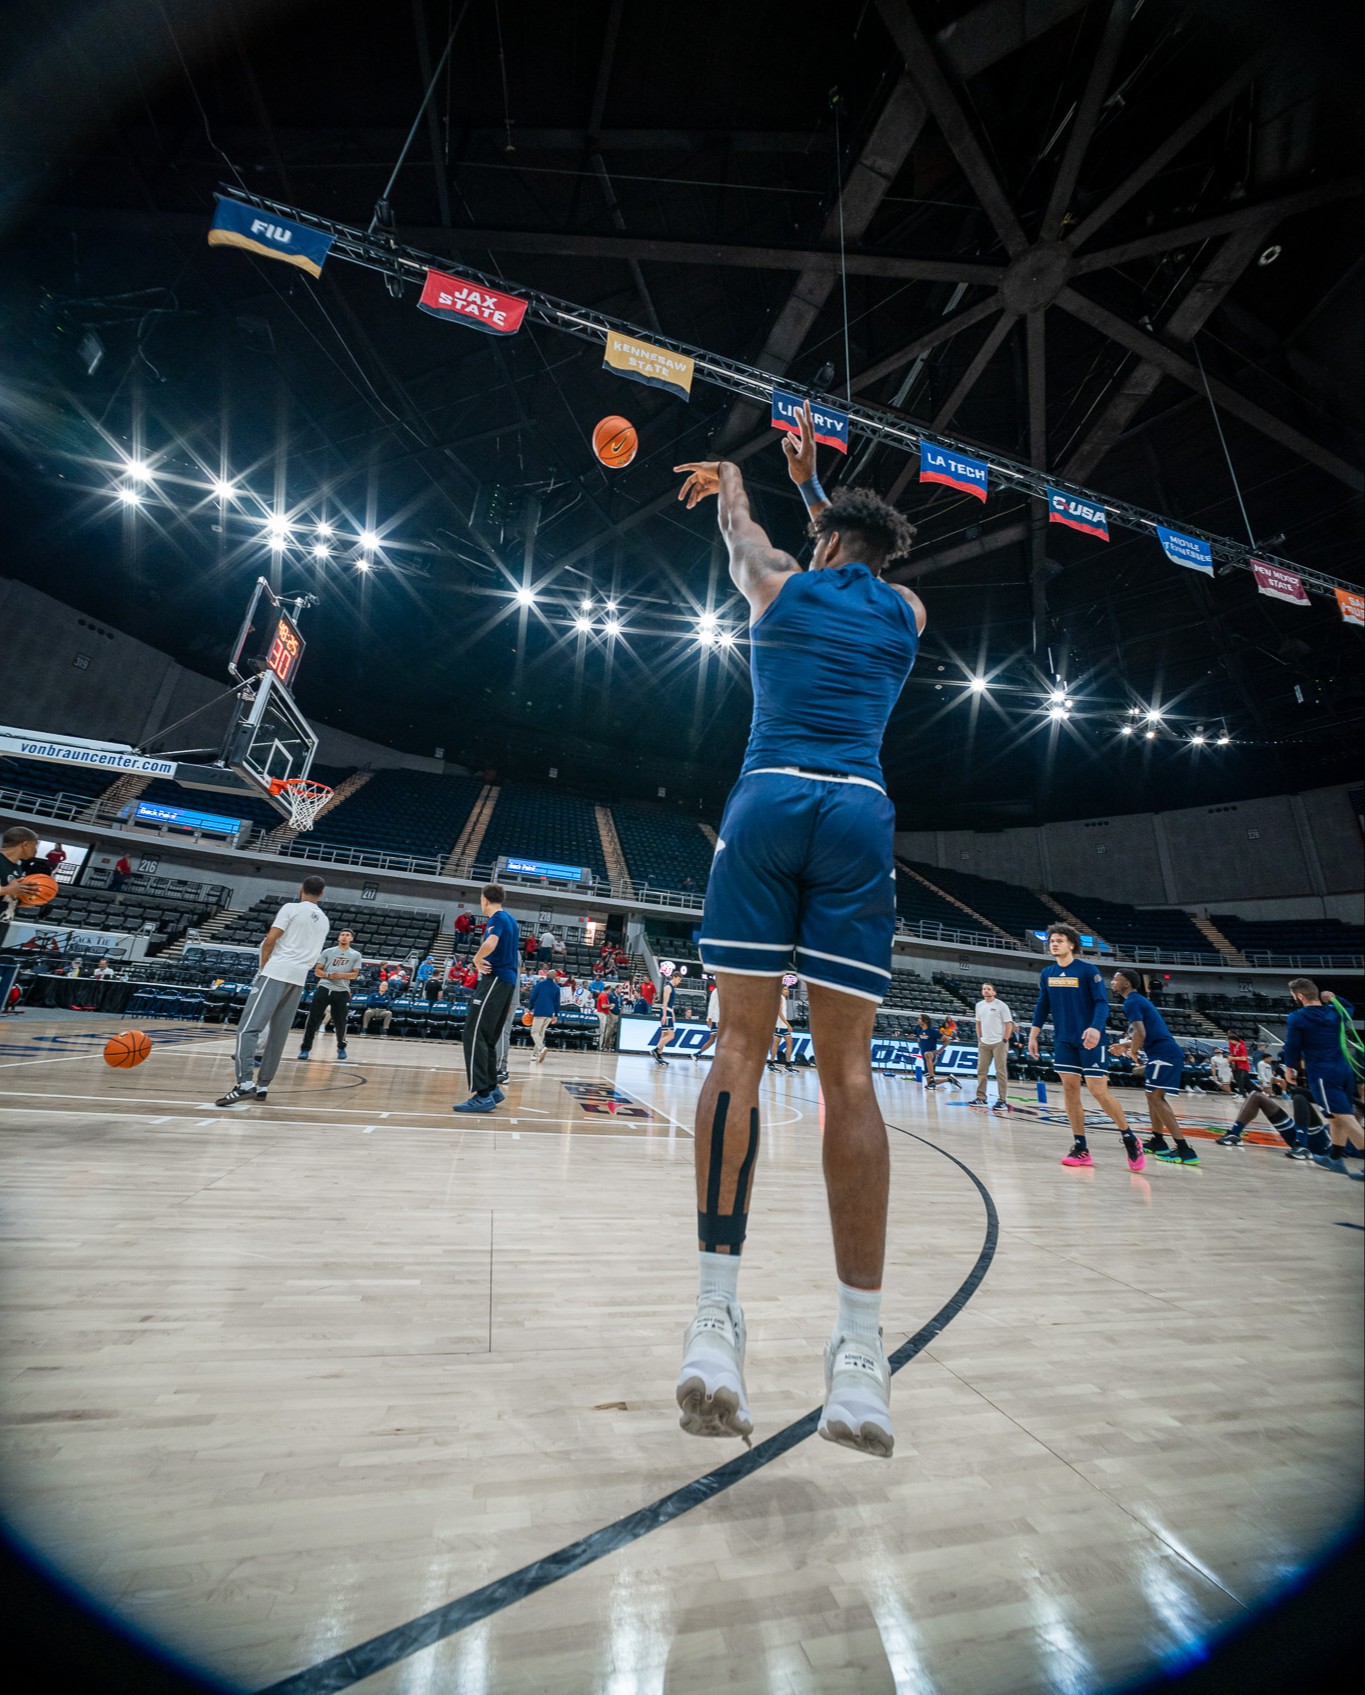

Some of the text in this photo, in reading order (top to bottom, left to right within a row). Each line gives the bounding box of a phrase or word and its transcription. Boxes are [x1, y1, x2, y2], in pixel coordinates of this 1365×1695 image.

[251, 219, 292, 243] FIU
[438, 292, 507, 327] STATE
[454, 288, 498, 310] JAX
[613, 341, 687, 372] KENNESAW
[628, 357, 669, 377] STATE
[927, 452, 985, 481] LA TECH
[1268, 579, 1294, 592] STATE
[268, 638, 292, 680] 30
[21, 743, 172, 774] vonbrauncenter.com
[139, 860, 158, 873] 216
[362, 888, 377, 900] 217
[540, 911, 551, 922] 218
